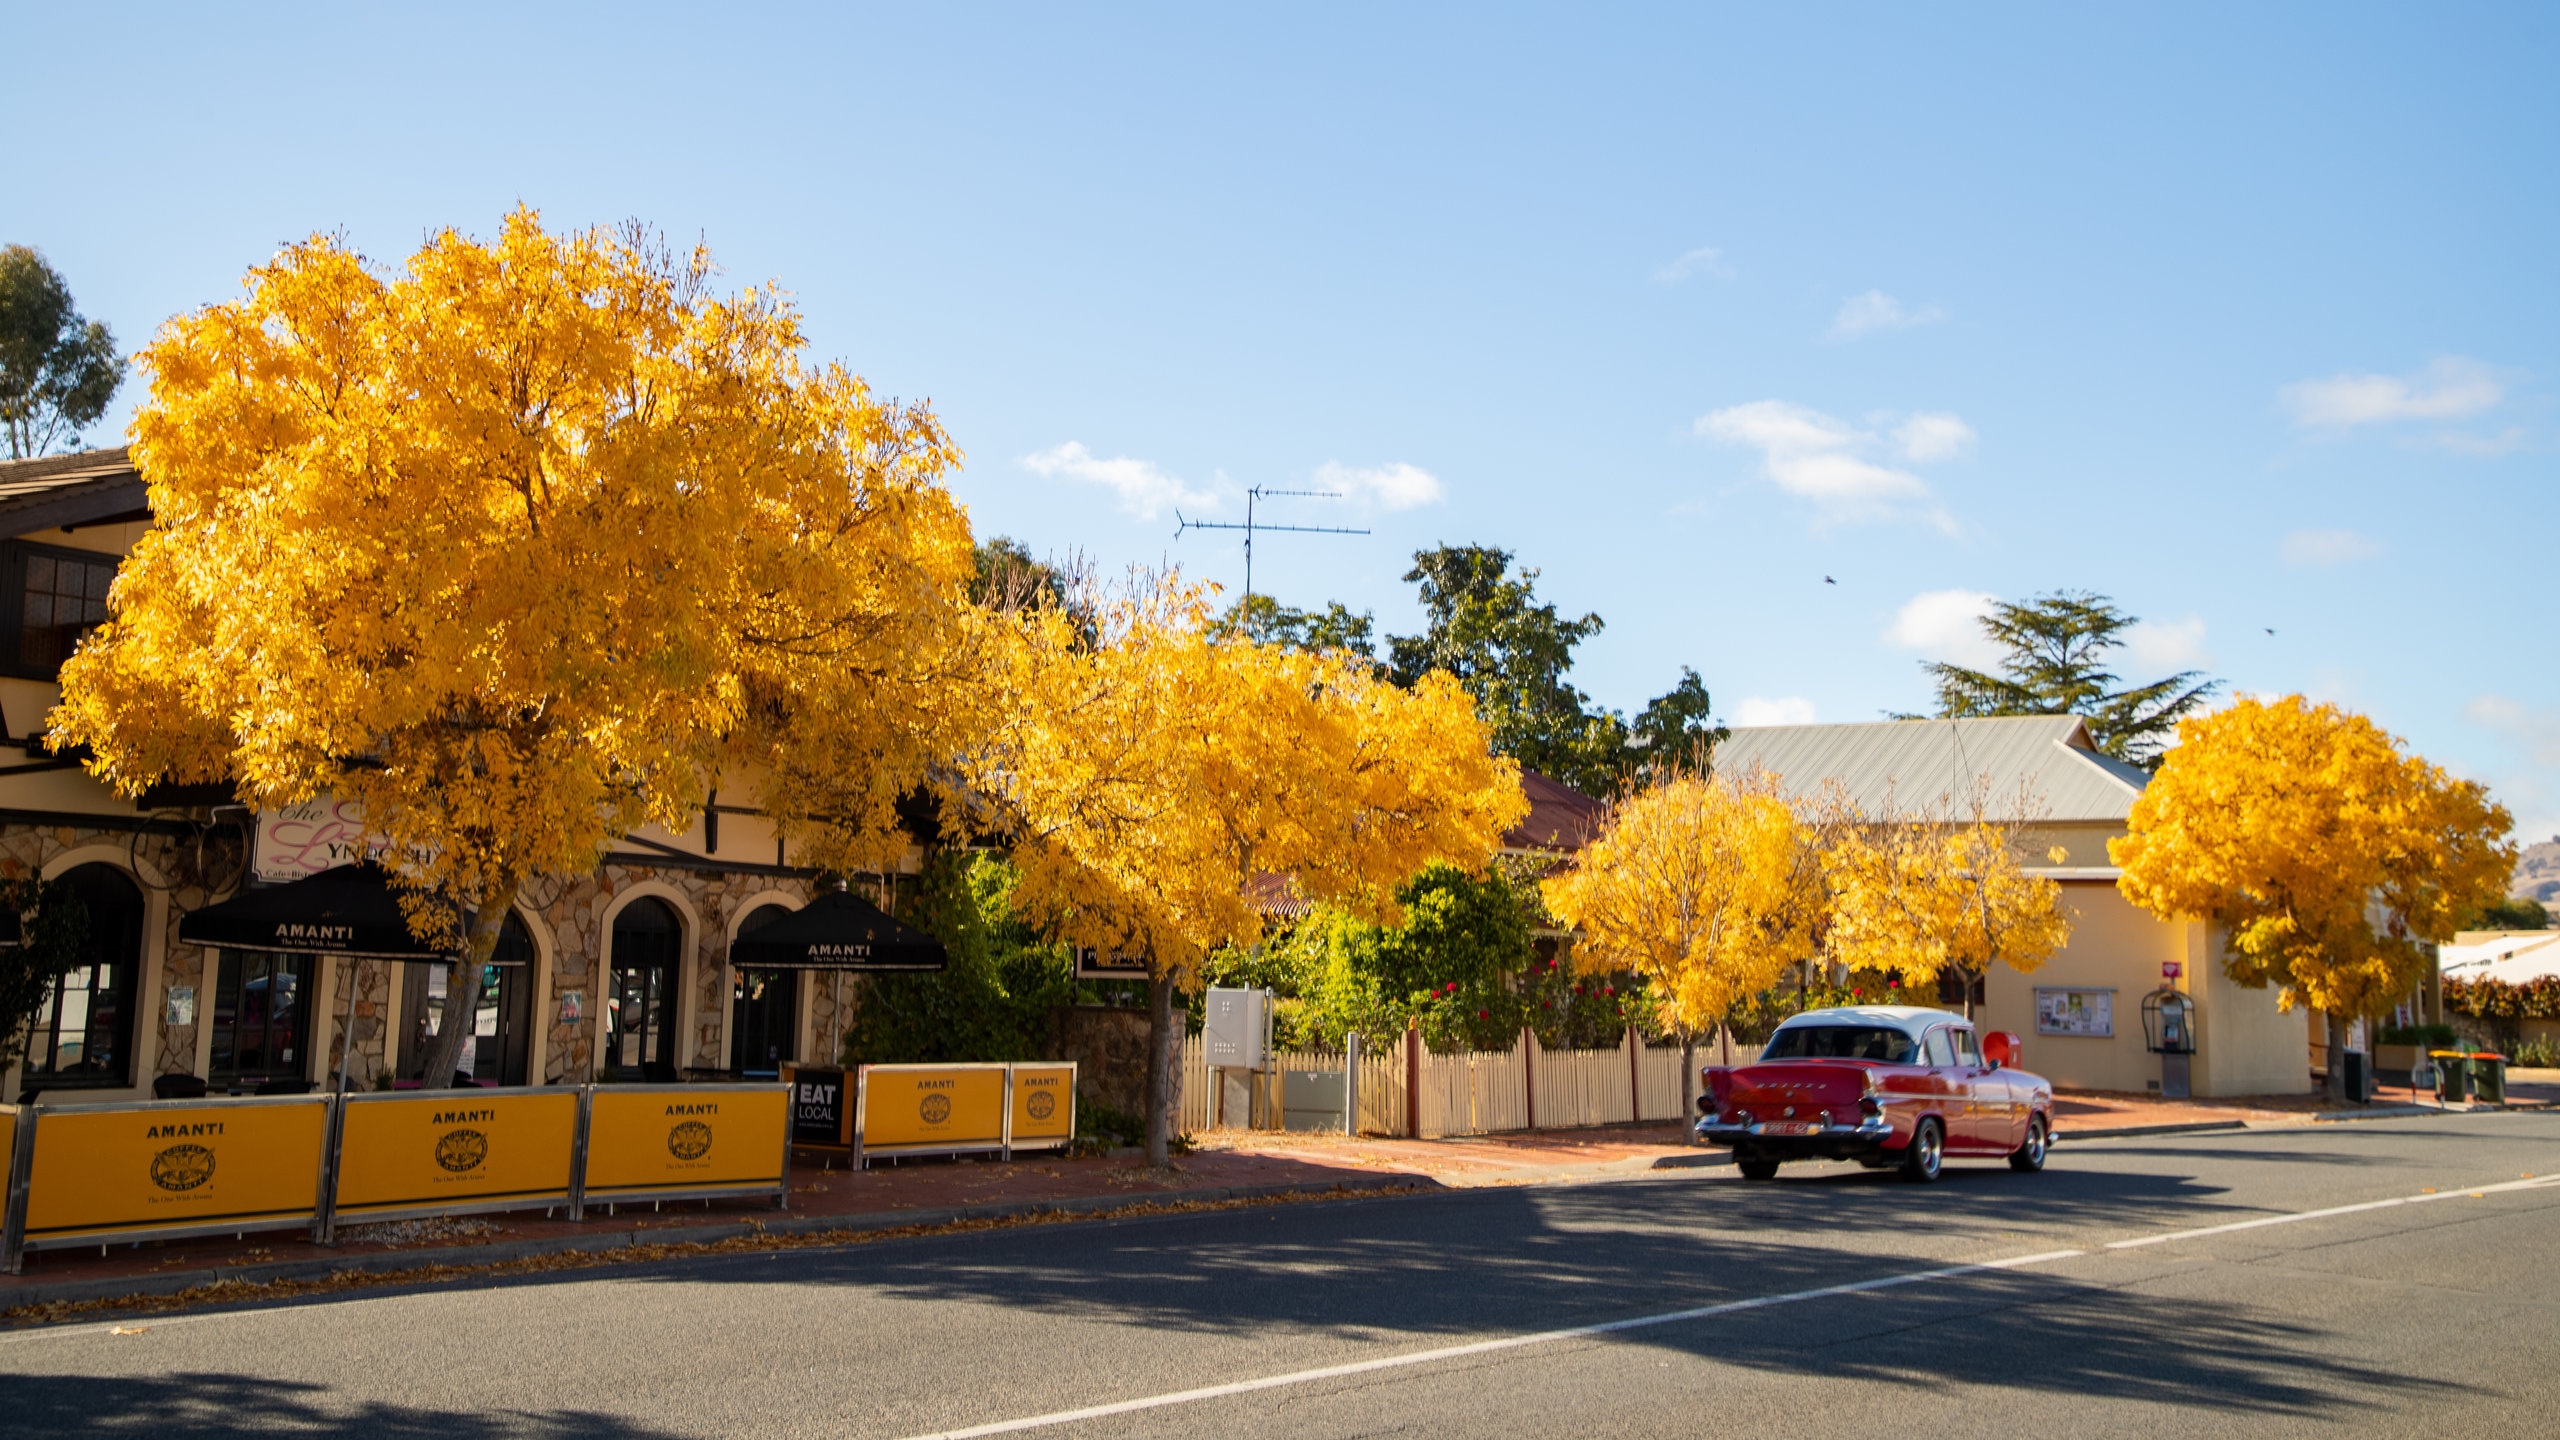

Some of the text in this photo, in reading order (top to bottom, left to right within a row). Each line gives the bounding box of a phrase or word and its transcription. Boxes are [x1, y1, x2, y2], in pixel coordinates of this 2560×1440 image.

[275, 923, 353, 940] AMANTI
[808, 944, 870, 956] AMANTI
[917, 1080, 955, 1089] AMANTI
[1024, 1077, 1058, 1087] AMANTI
[800, 1083, 836, 1105] EAT
[432, 1109, 494, 1124] AMANTI
[665, 1104, 718, 1116] AMANTI
[799, 1105, 834, 1120] LOCAL
[146, 1123, 224, 1138] AMANTI
